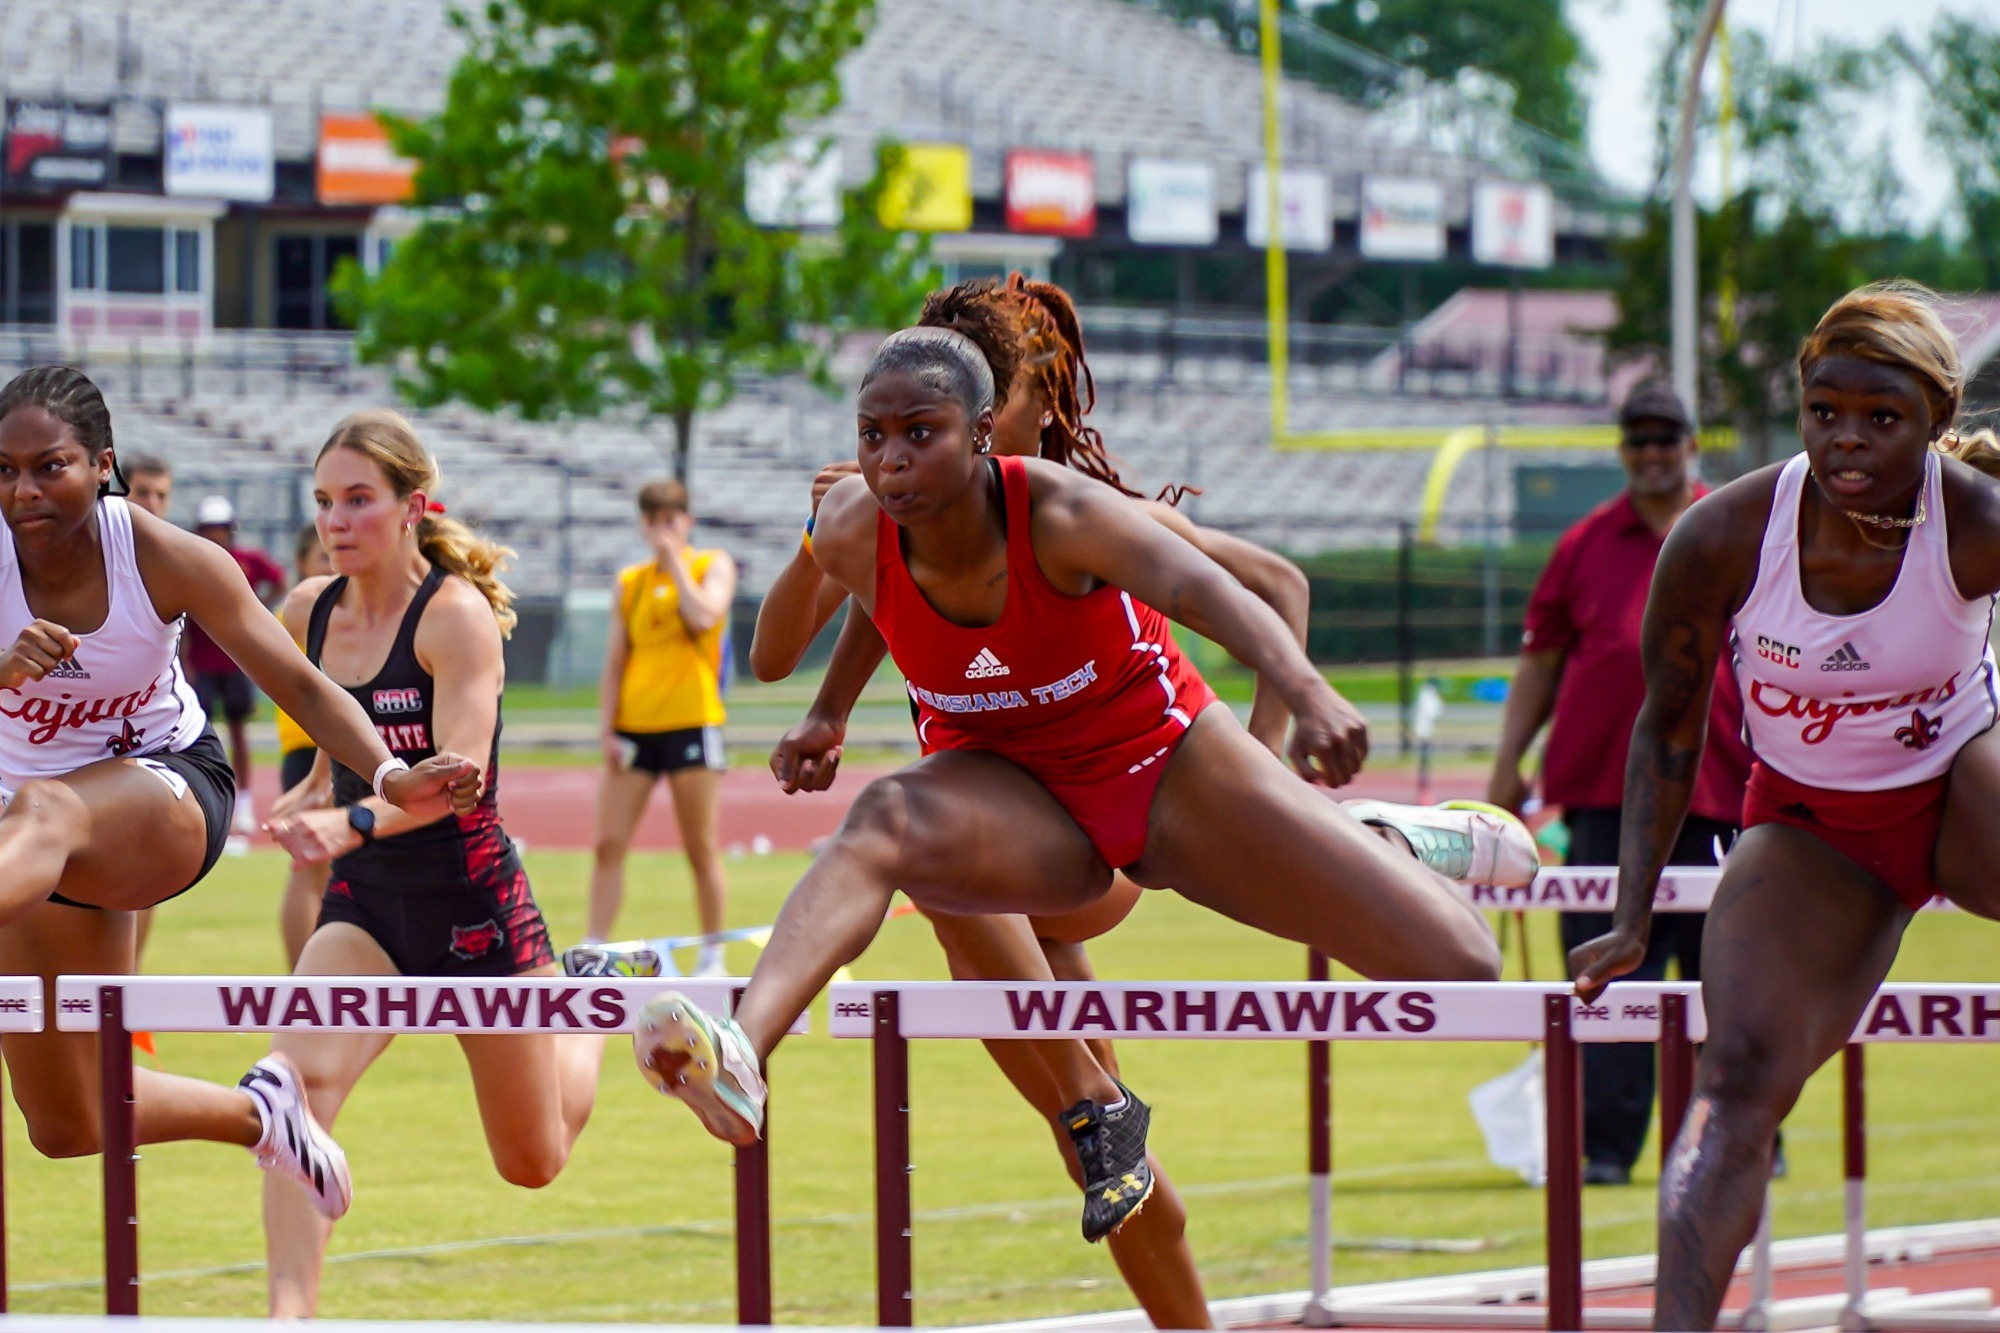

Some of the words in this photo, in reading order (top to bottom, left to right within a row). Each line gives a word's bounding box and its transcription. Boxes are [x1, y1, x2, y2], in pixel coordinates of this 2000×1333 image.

[1757, 635, 1801, 670] SBC
[1820, 660, 1871, 672] adidas
[48, 669, 91, 680] adidas
[965, 665, 1011, 679] adidas
[1031, 660, 1097, 704] TECH
[0, 673, 161, 745] Cajuns
[220, 986, 626, 1028] WARHAWKS
[1006, 990, 1437, 1032] WARHAWKS
